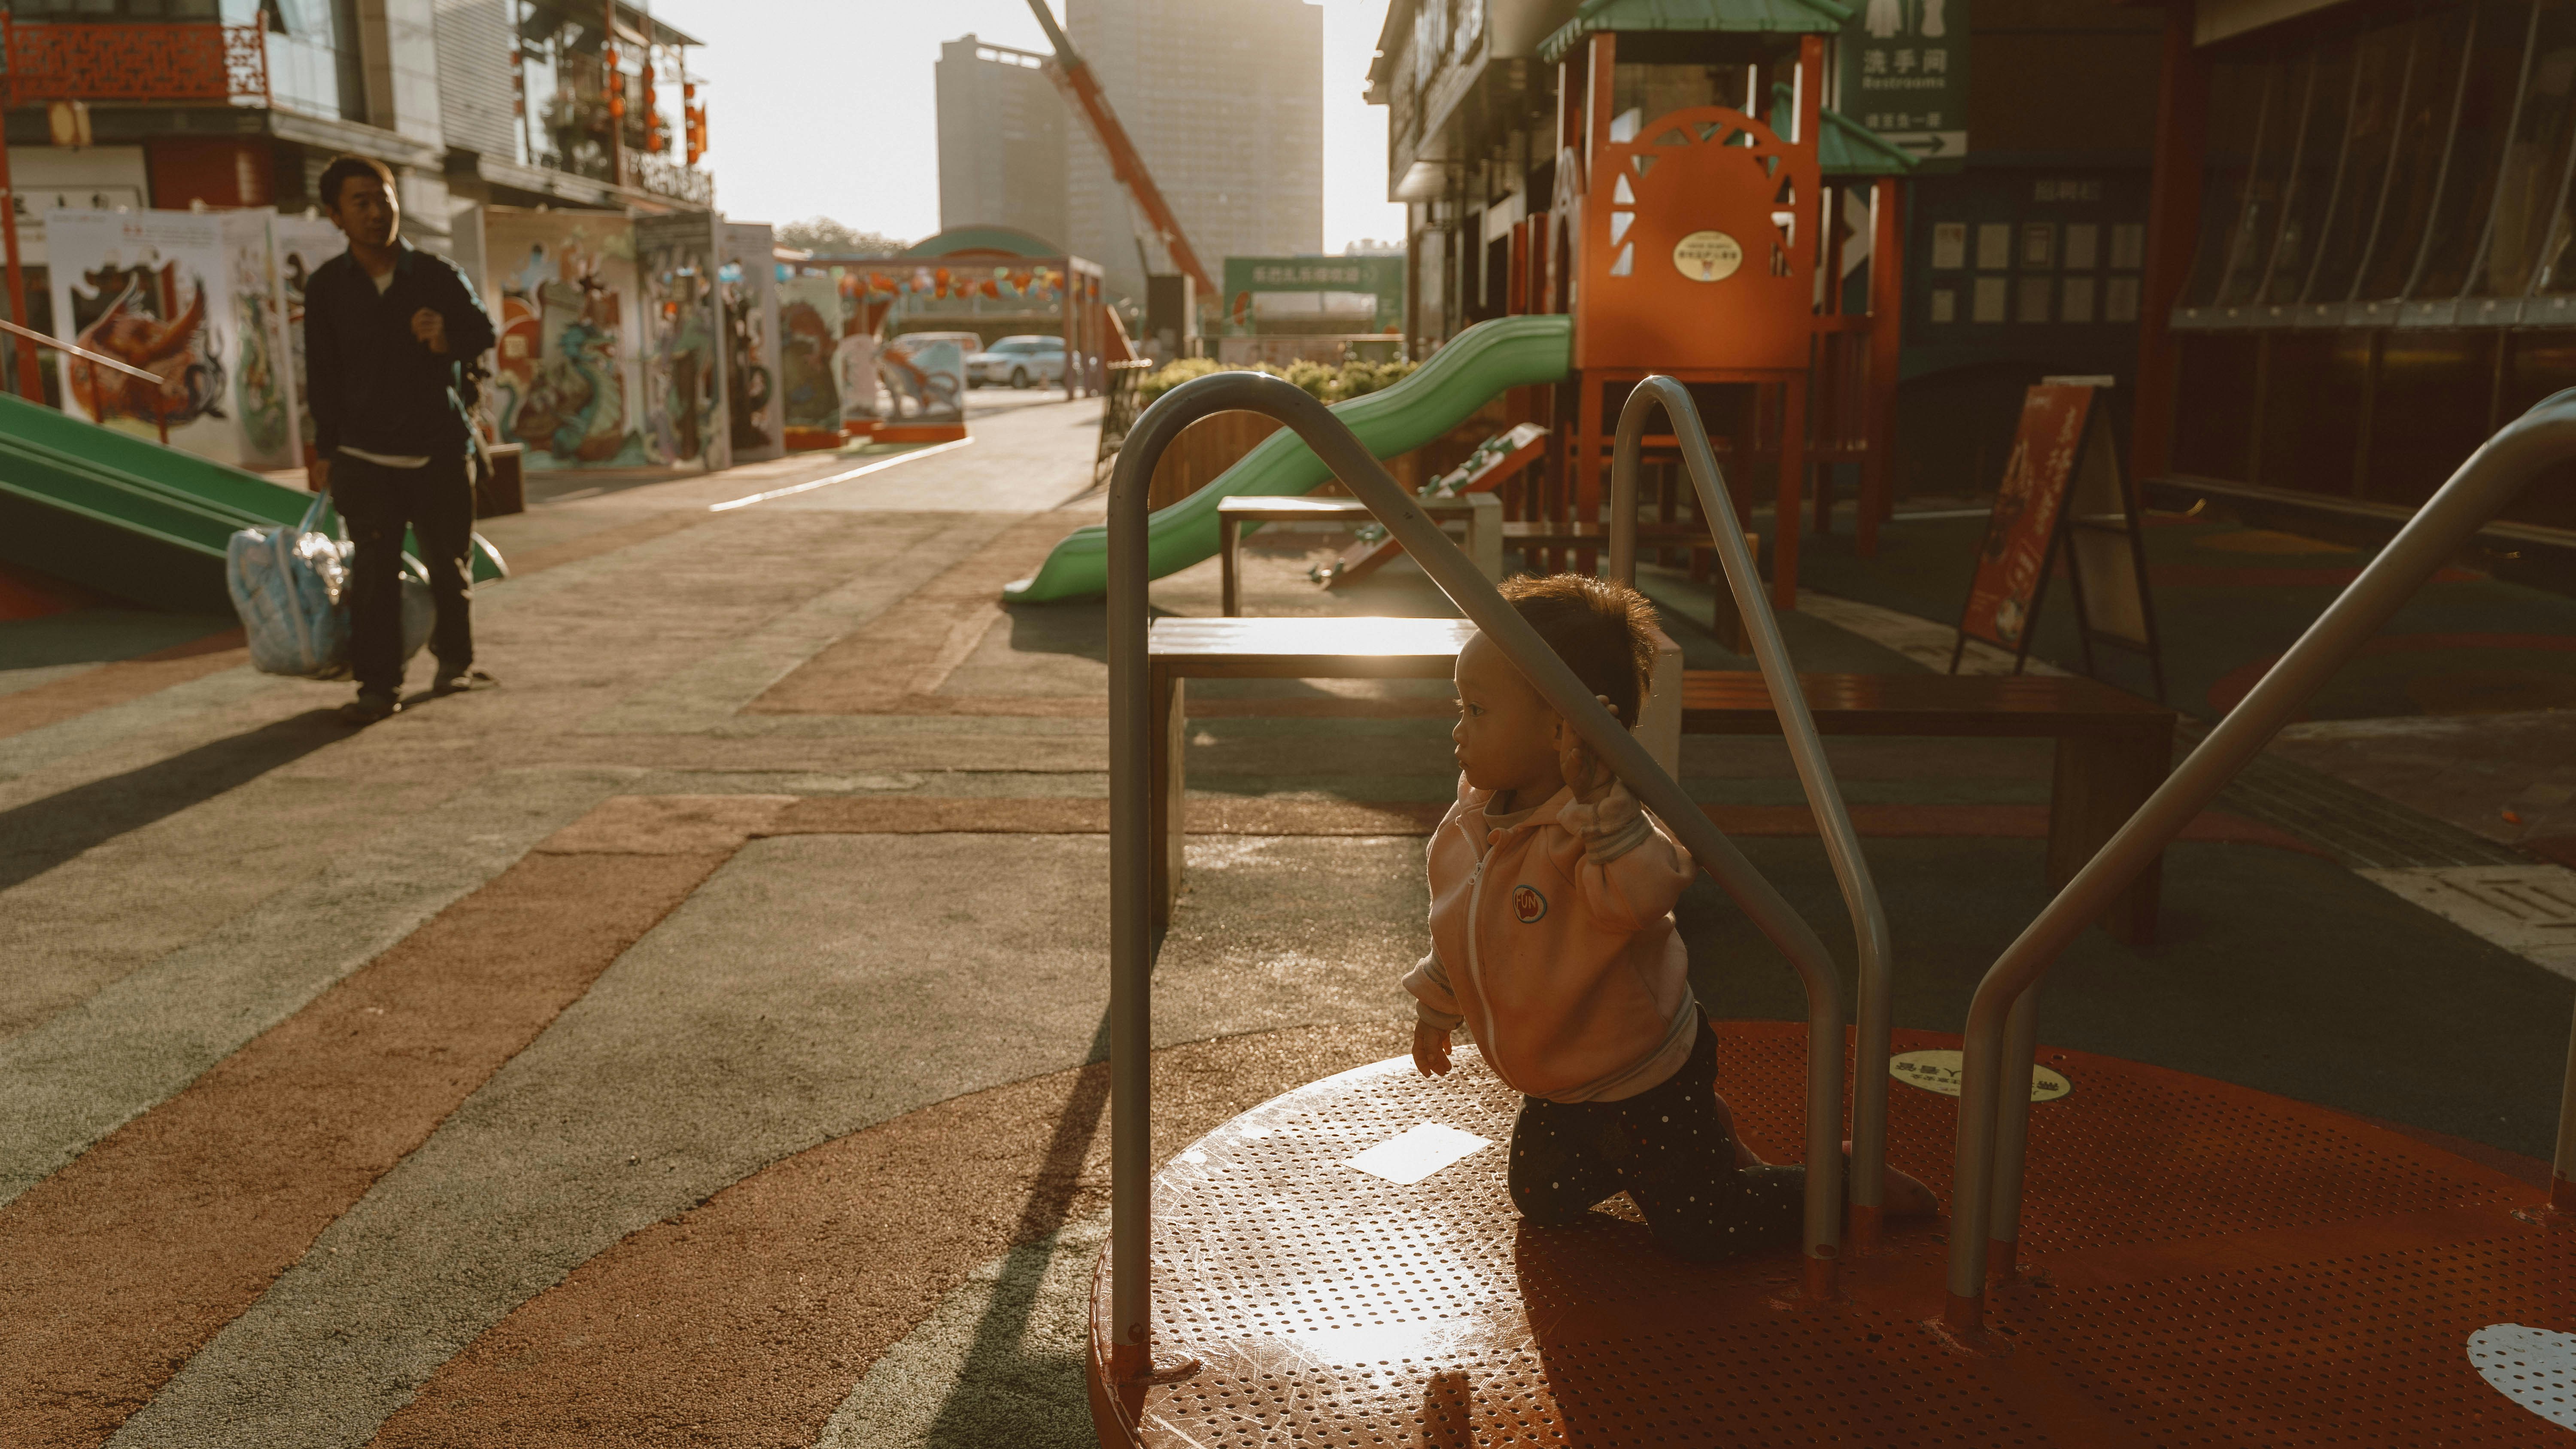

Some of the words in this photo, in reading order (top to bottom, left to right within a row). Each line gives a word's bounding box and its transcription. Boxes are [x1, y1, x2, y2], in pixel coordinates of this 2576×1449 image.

[1862, 49, 1947, 73] 洗手间
[1863, 76, 1945, 88] Restrooms
[1516, 893, 1536, 909] FUN
